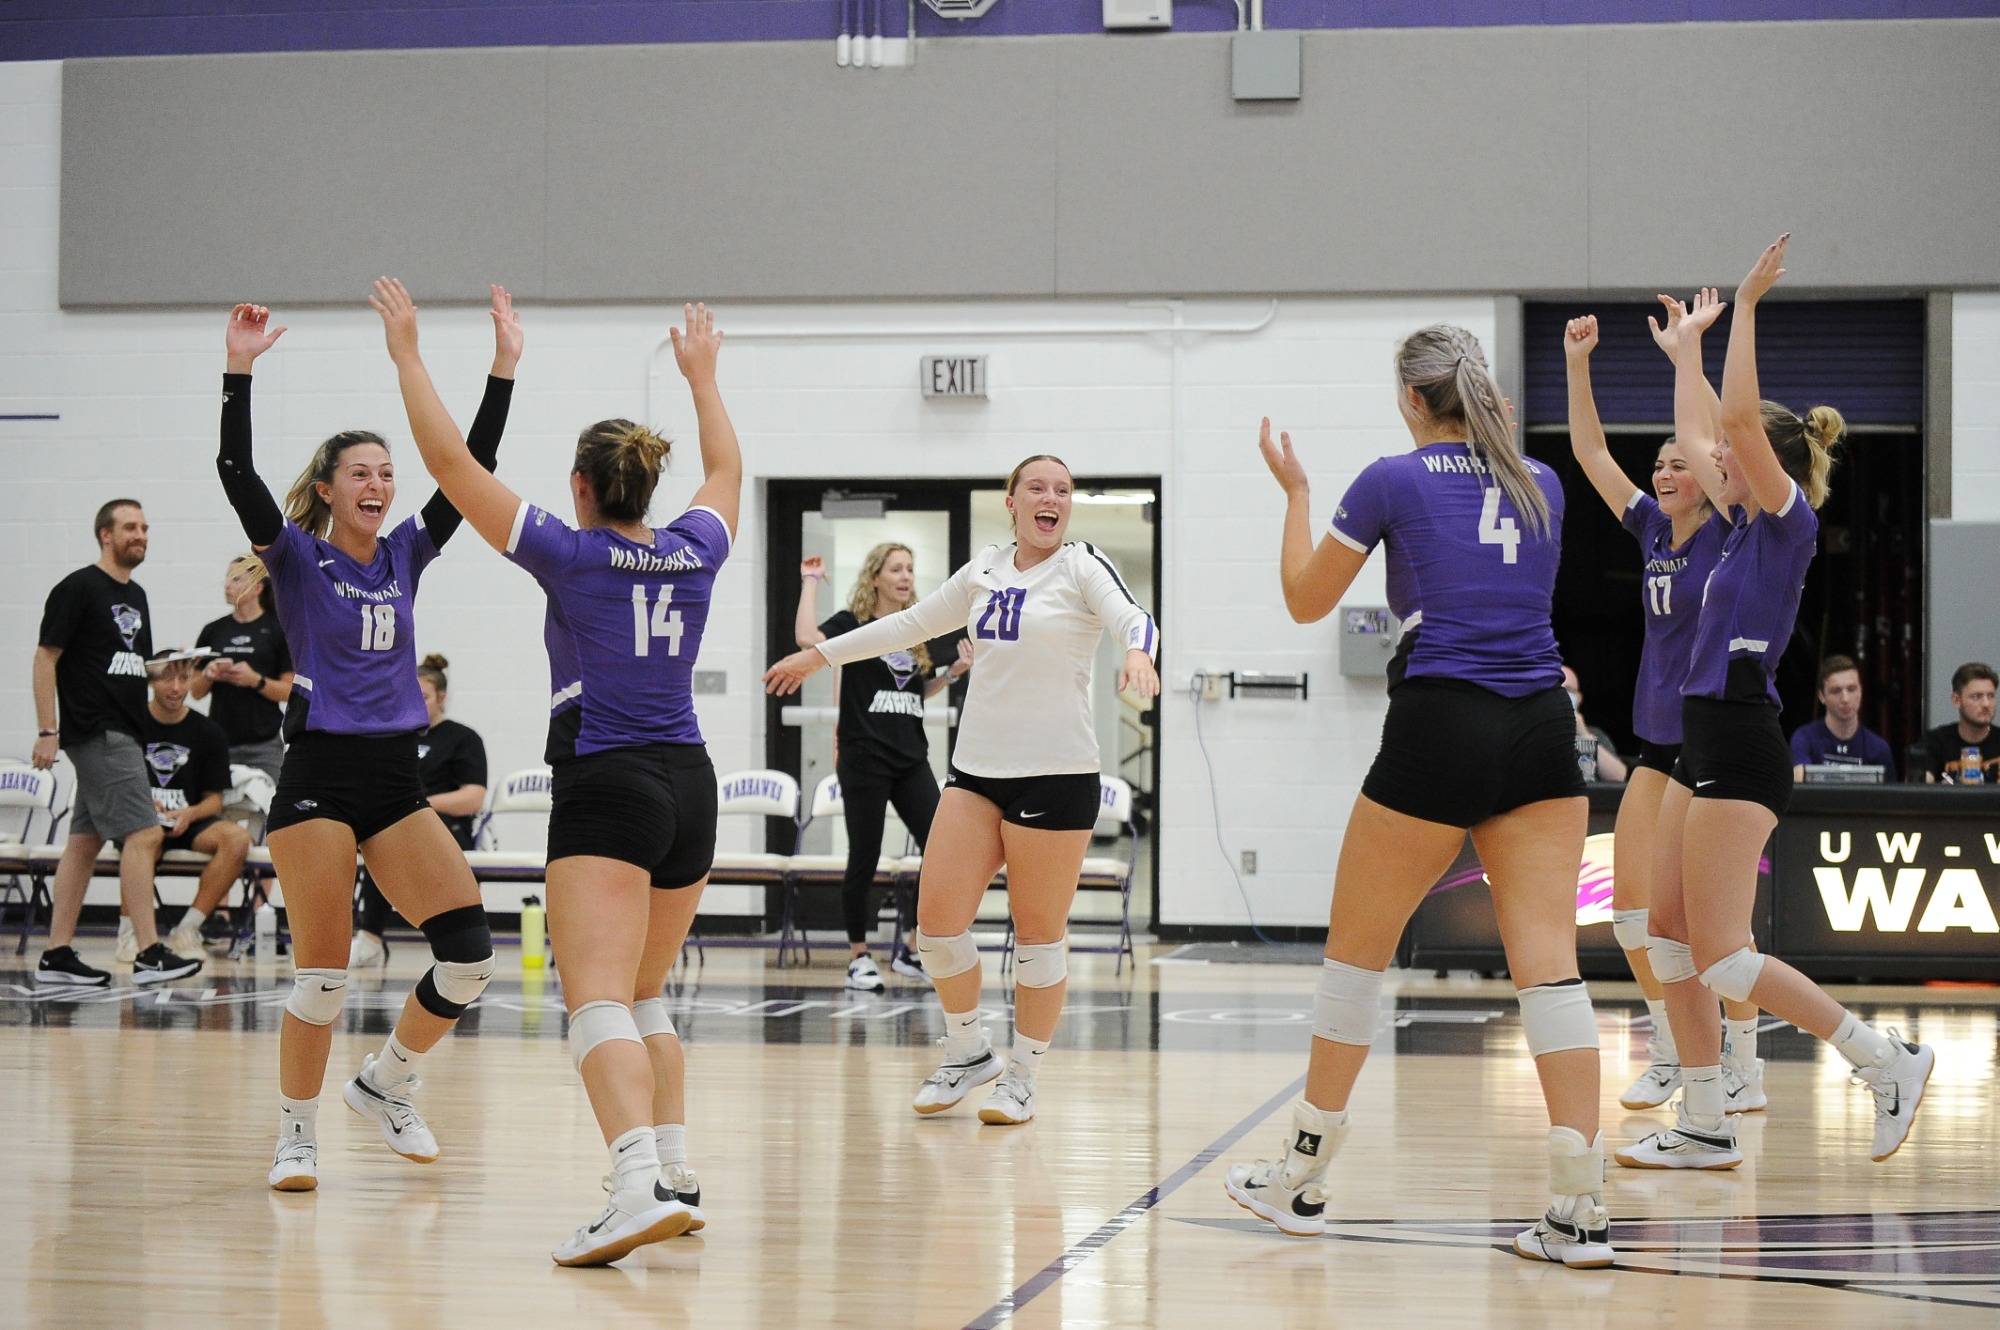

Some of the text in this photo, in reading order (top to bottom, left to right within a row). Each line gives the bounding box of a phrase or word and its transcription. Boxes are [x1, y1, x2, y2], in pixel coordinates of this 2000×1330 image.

[933, 359, 977, 393] EXIT
[1478, 487, 1521, 564] 4
[631, 584, 684, 655] 14
[976, 586, 1028, 642] 20
[1648, 575, 1672, 615] 17
[361, 604, 396, 651] 18
[723, 778, 783, 802] WARHAWKS
[1812, 867, 2000, 934] WA
